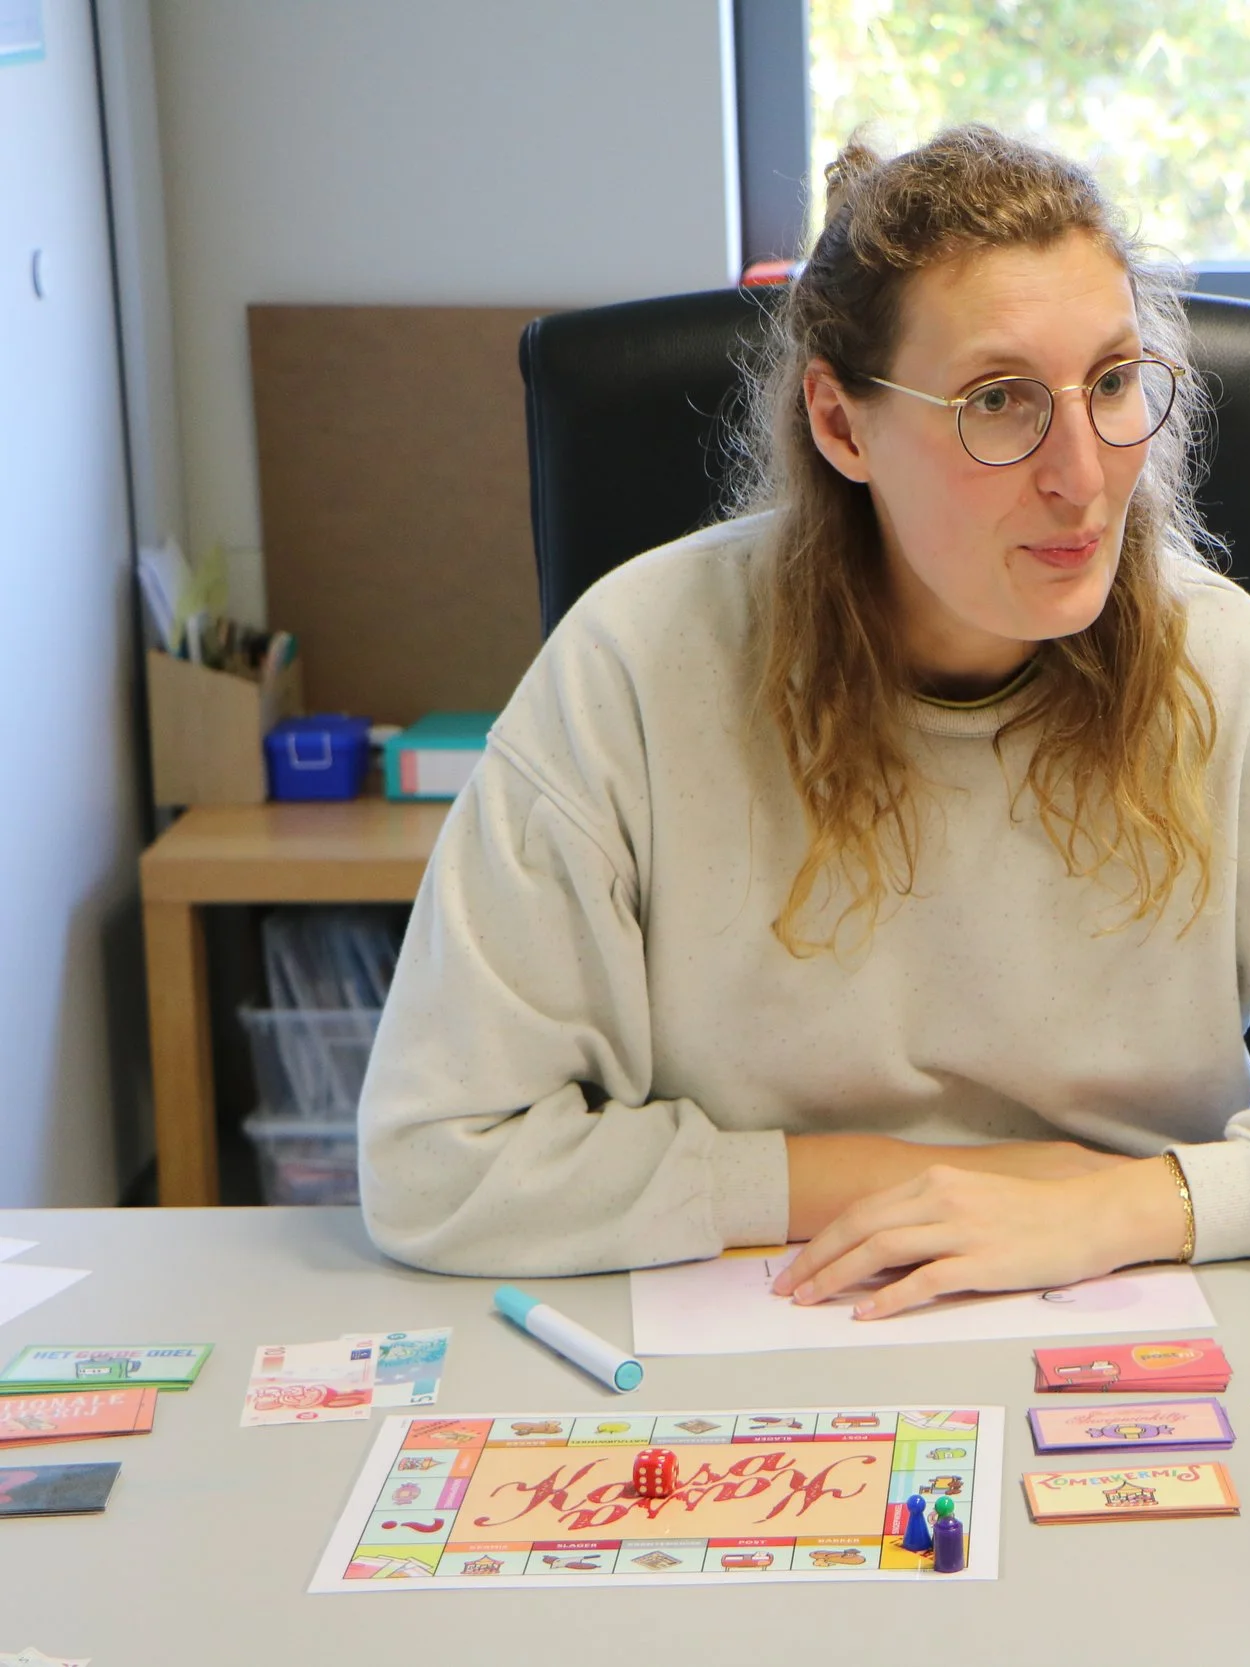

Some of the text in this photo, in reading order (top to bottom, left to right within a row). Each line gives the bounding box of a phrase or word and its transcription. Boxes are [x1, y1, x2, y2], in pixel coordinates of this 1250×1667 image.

[33, 1351, 74, 1359] HET
[146, 1349, 196, 1358] DOEL
[1038, 1465, 1200, 1490] ZOMERKERMIS
